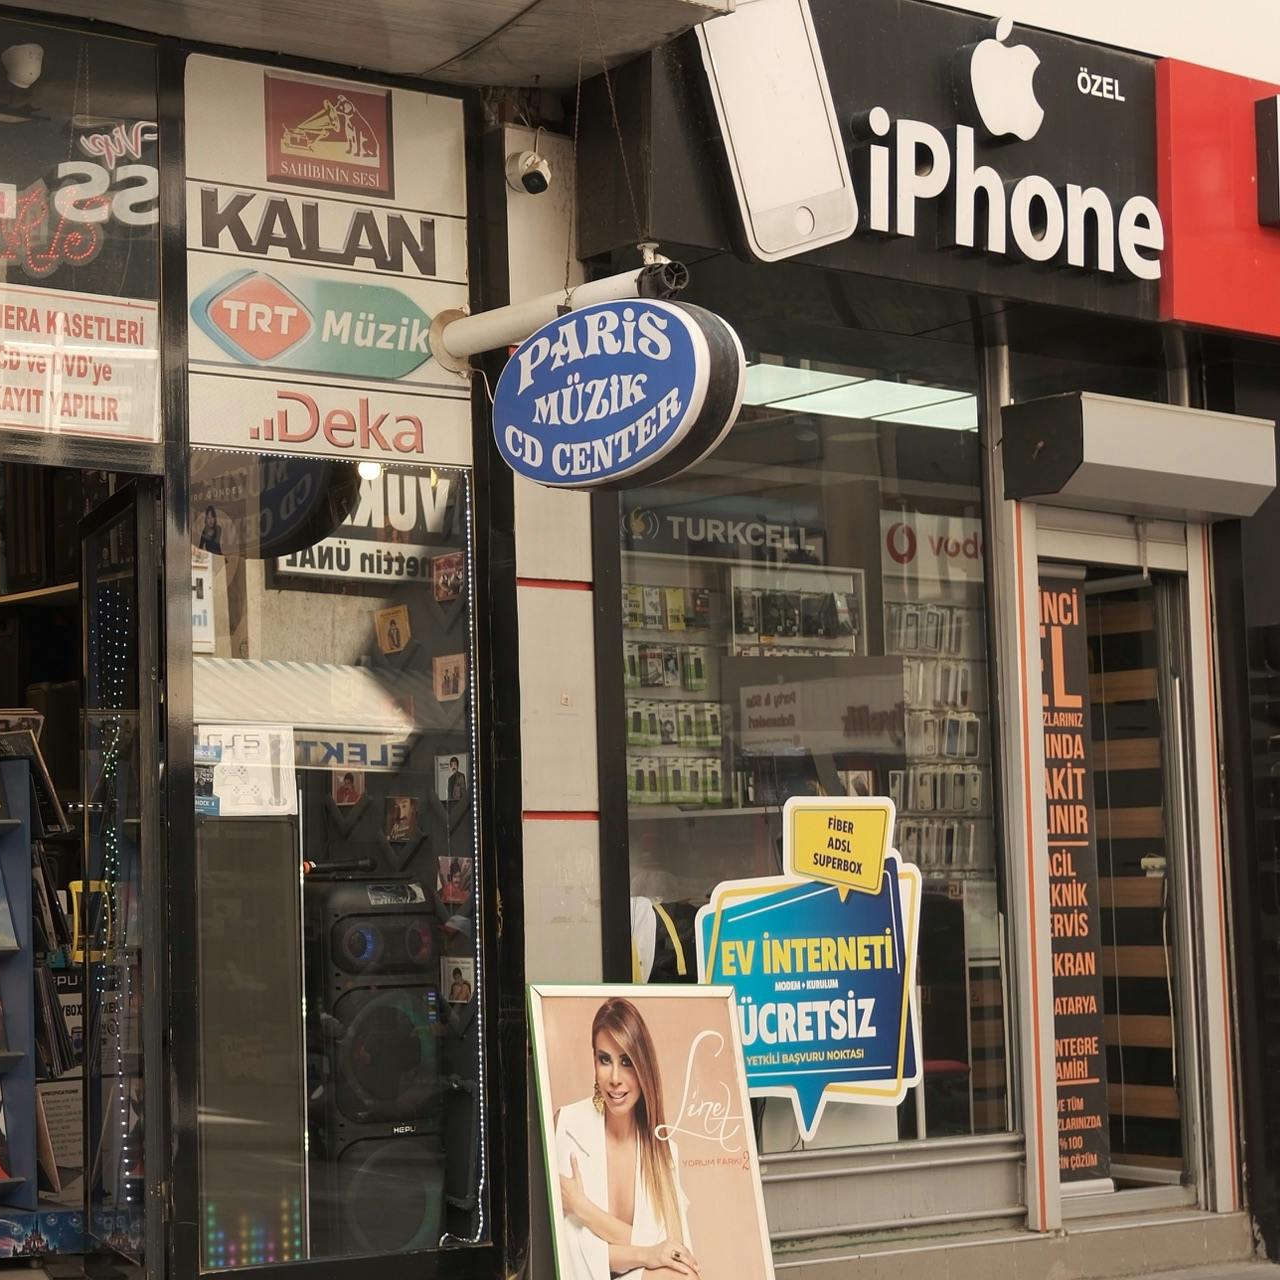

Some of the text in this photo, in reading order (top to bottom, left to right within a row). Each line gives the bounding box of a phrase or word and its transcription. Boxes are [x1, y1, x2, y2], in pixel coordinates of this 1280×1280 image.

[1077, 68, 1125, 103] ÖZEL
[280, 160, 380, 188] SAHİBİNİN SESİ
[868, 106, 1165, 281] iPhone
[200, 187, 437, 277] KALAN
[46, 309, 145, 346] KASETLERİ
[222, 299, 430, 354] TRT Müzik
[27, 354, 47, 375] ve
[49, 391, 119, 422] YAPILIR
[276, 390, 425, 454] Deka
[504, 387, 683, 477] CD CENTER
[666, 515, 816, 552] TURKCELL
[928, 531, 984, 561] vod
[827, 815, 855, 835] FİBER
[1046, 804, 1088, 835] INIR
[826, 836, 852, 854] ADSL
[813, 852, 863, 876] SUPERBOX
[1049, 878, 1088, 908] KNİK
[721, 927, 894, 976] EV İNTERNETİ
[1052, 951, 1096, 977] KRAN
[774, 979, 802, 992] MODEM
[807, 978, 839, 991] KURULUM
[738, 990, 877, 1047] ÜCRETSİZ
[746, 1048, 865, 1067] YETKİLİ BAŞVURU NOKTASI
